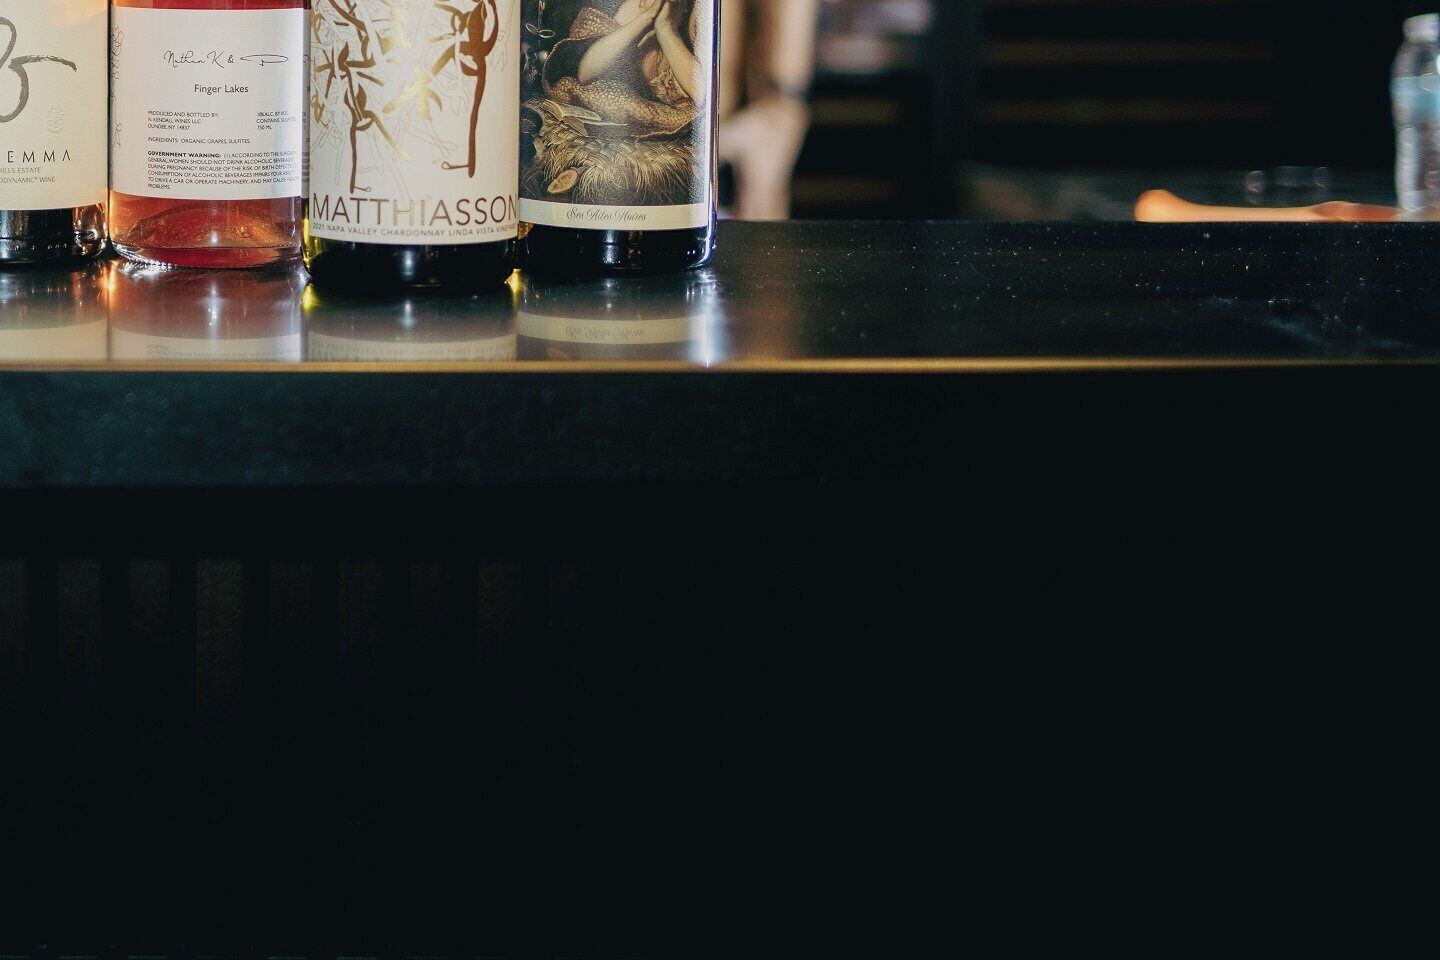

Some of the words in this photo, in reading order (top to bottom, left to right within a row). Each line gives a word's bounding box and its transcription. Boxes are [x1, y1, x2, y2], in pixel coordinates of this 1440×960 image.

[227, 54, 235, 64] &
[194, 83, 222, 95] Finger
[224, 84, 249, 93] Lakes
[312, 192, 518, 226] MATTHIASSON
[312, 222, 325, 230] 2021
[326, 224, 345, 234] NAPA
[347, 226, 377, 236] VALLEY
[380, 228, 445, 237] CHARDONNAY
[448, 227, 474, 236] LINDA
[476, 226, 495, 235] VISTA
